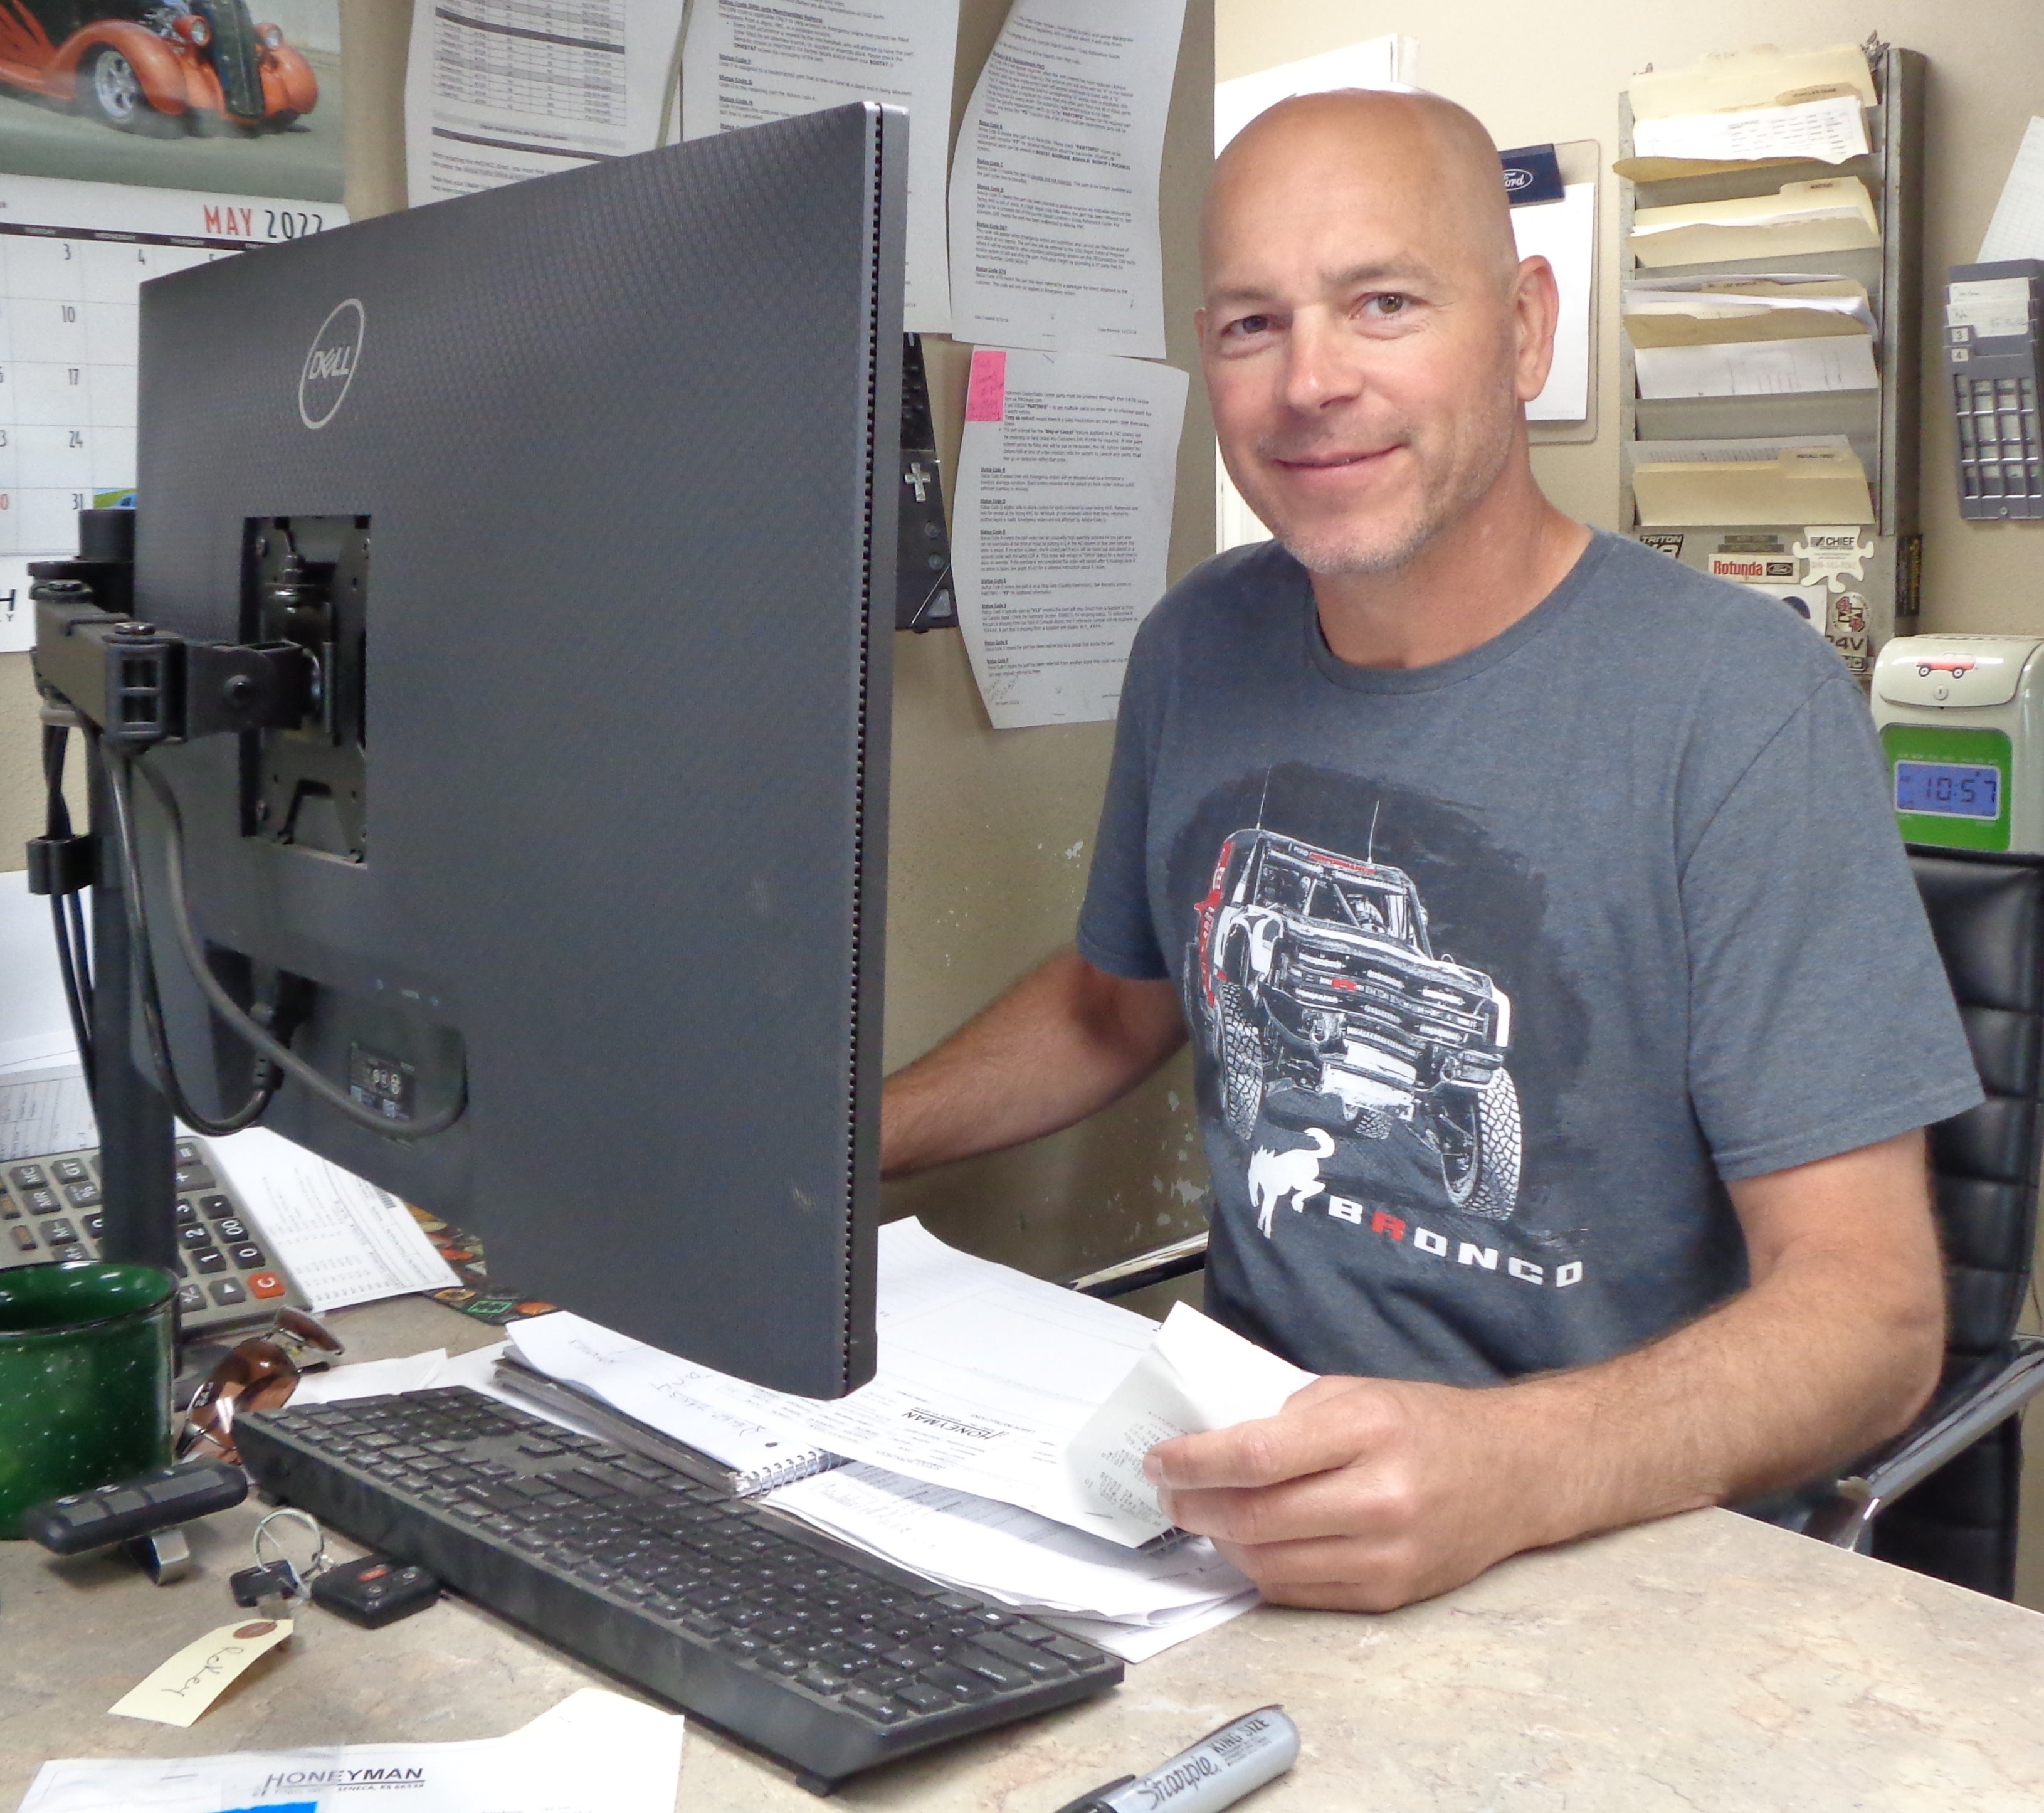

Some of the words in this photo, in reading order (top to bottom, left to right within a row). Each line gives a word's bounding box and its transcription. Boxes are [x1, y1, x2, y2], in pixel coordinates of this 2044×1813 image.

[202, 204, 252, 237] MAY
[63, 243, 71, 260] 3
[138, 248, 145, 265] 4
[61, 305, 75, 323] 10
[1956, 330, 1962, 340] 3
[308, 346, 351, 380] DELL
[1956, 351, 1962, 360] 4
[68, 368, 80, 386] 17
[68, 431, 83, 448] 24
[72, 493, 83, 510] 31
[1640, 534, 1683, 544] TRITON
[1826, 537, 1855, 546] CHIEF
[1714, 560, 1764, 576] Rotunda
[1927, 776, 1996, 803] 10:57
[21, 1166, 41, 1183] MC
[63, 1163, 81, 1176] GT
[34, 1191, 52, 1207] MR
[184, 1227, 206, 1239] 2
[221, 1219, 244, 1235] 00
[1328, 1193, 1584, 1288] BRONCO
[200, 1254, 219, 1263] 1
[238, 1247, 258, 1258] 0
[256, 1277, 276, 1289] C
[901, 1410, 1002, 1441] HONEYMAN
[1208, 1733, 1242, 1754] KING
[1243, 1718, 1270, 1738] SIZE
[260, 1767, 424, 1797] HONEYMAN
